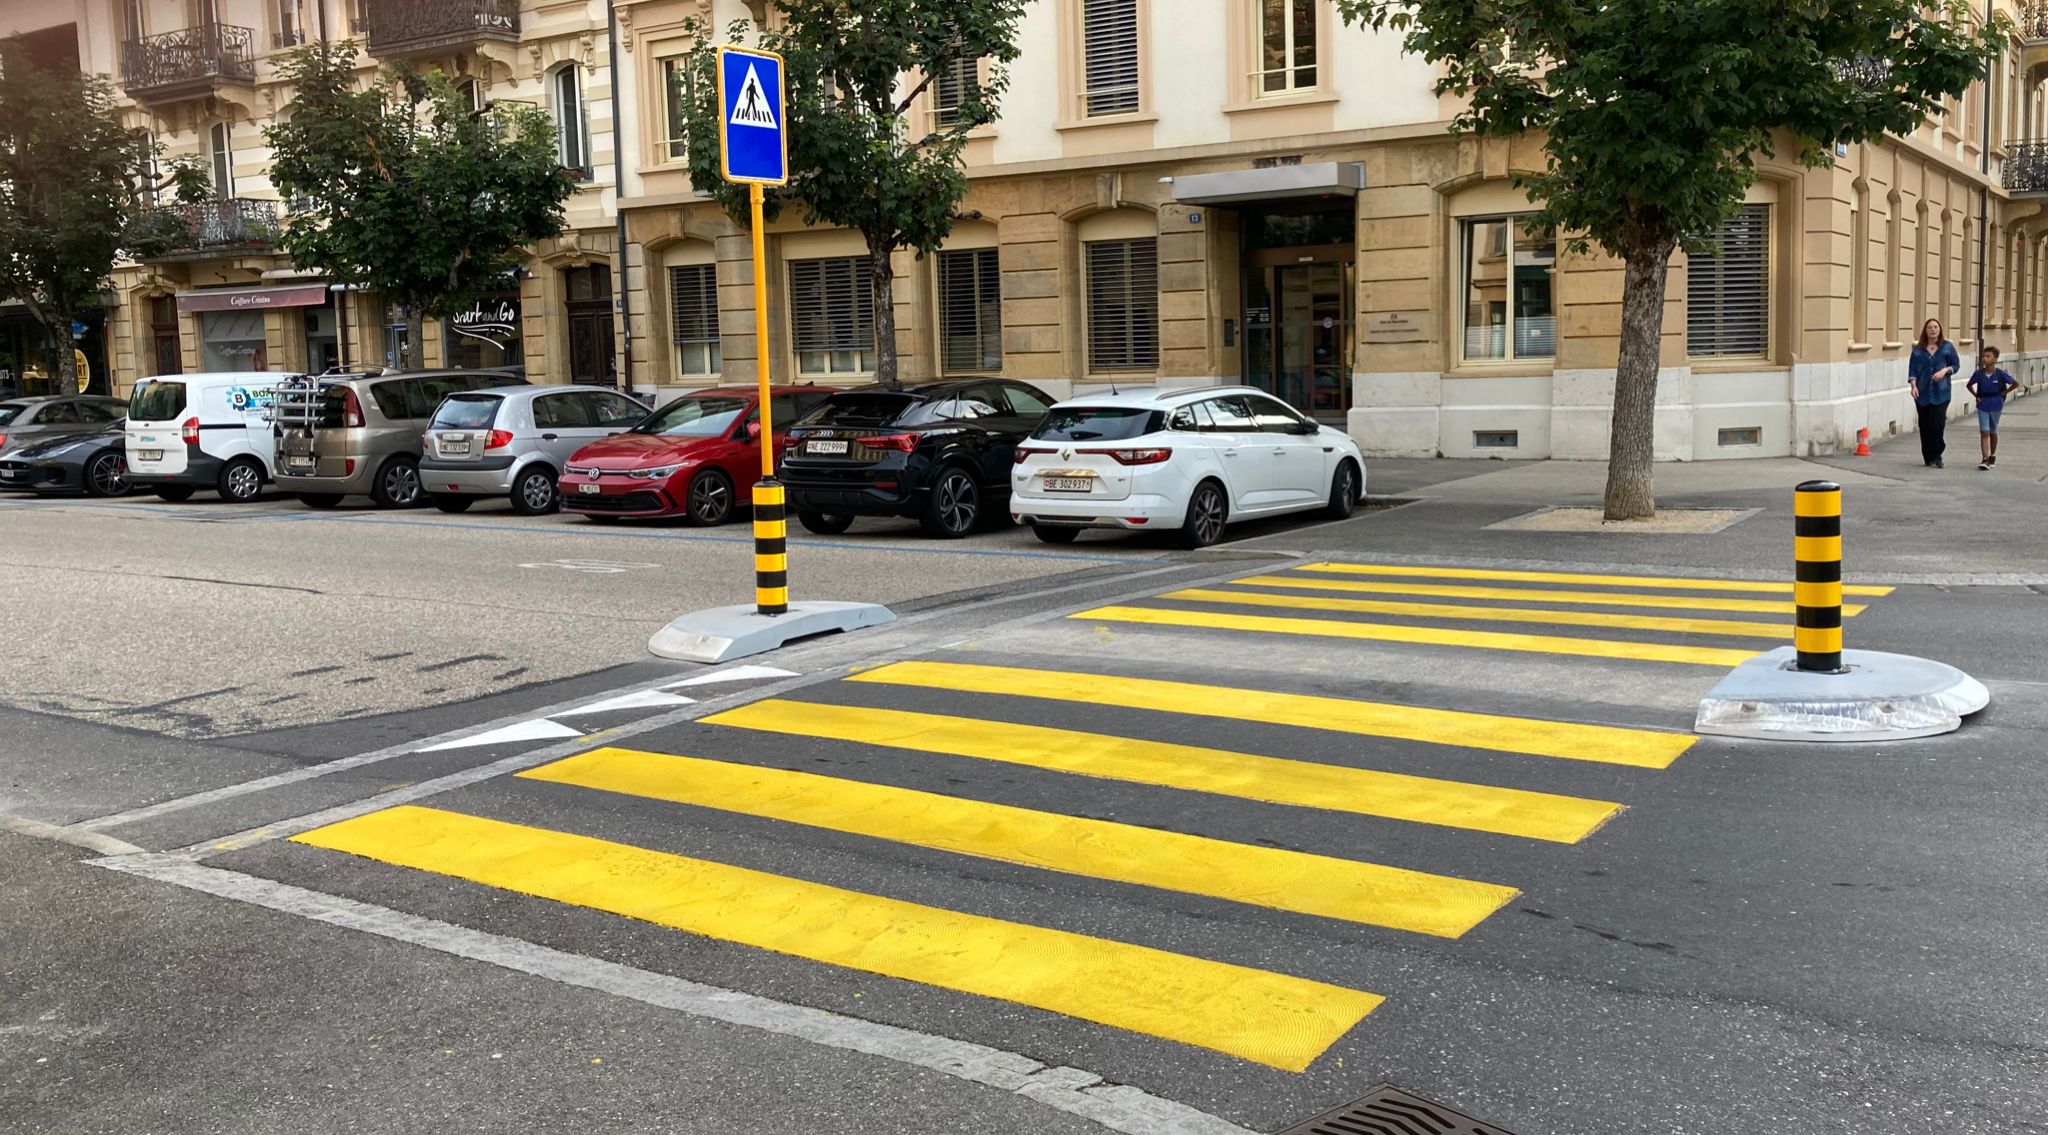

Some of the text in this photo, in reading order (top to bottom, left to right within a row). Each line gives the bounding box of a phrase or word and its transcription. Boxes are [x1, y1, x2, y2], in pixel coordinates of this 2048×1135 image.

[500, 301, 514, 321] Go
[1049, 479, 1085, 489] BE 302937
